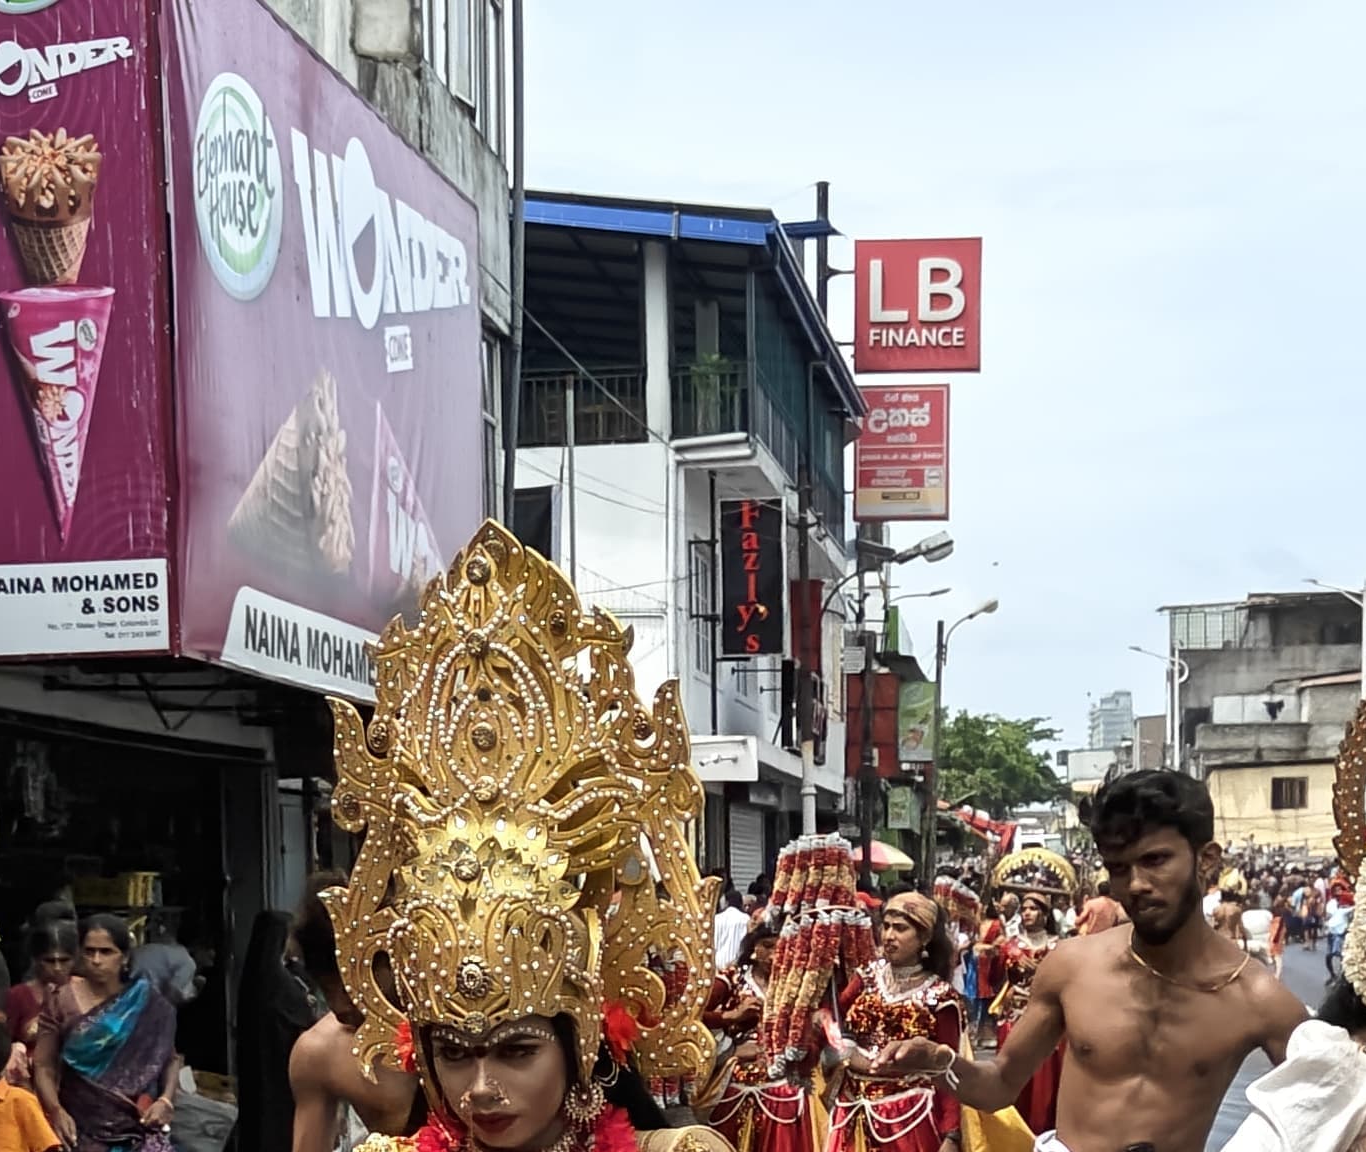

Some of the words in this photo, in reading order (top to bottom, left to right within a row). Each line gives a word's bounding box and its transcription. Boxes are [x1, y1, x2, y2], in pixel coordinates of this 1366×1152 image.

[197, 92, 275, 198] Elephant
[209, 180, 260, 249] House
[291, 127, 470, 329] WONDER
[870, 257, 965, 322] LB
[869, 326, 965, 347] FINANCE
[868, 401, 931, 433] උකස්
[52, 572, 159, 593] MOHAMED
[81, 598, 96, 614] &
[103, 595, 160, 613] SONS
[737, 500, 769, 653] Fazly's
[244, 604, 302, 666] NAINA
[306, 627, 376, 687] MOHAME
